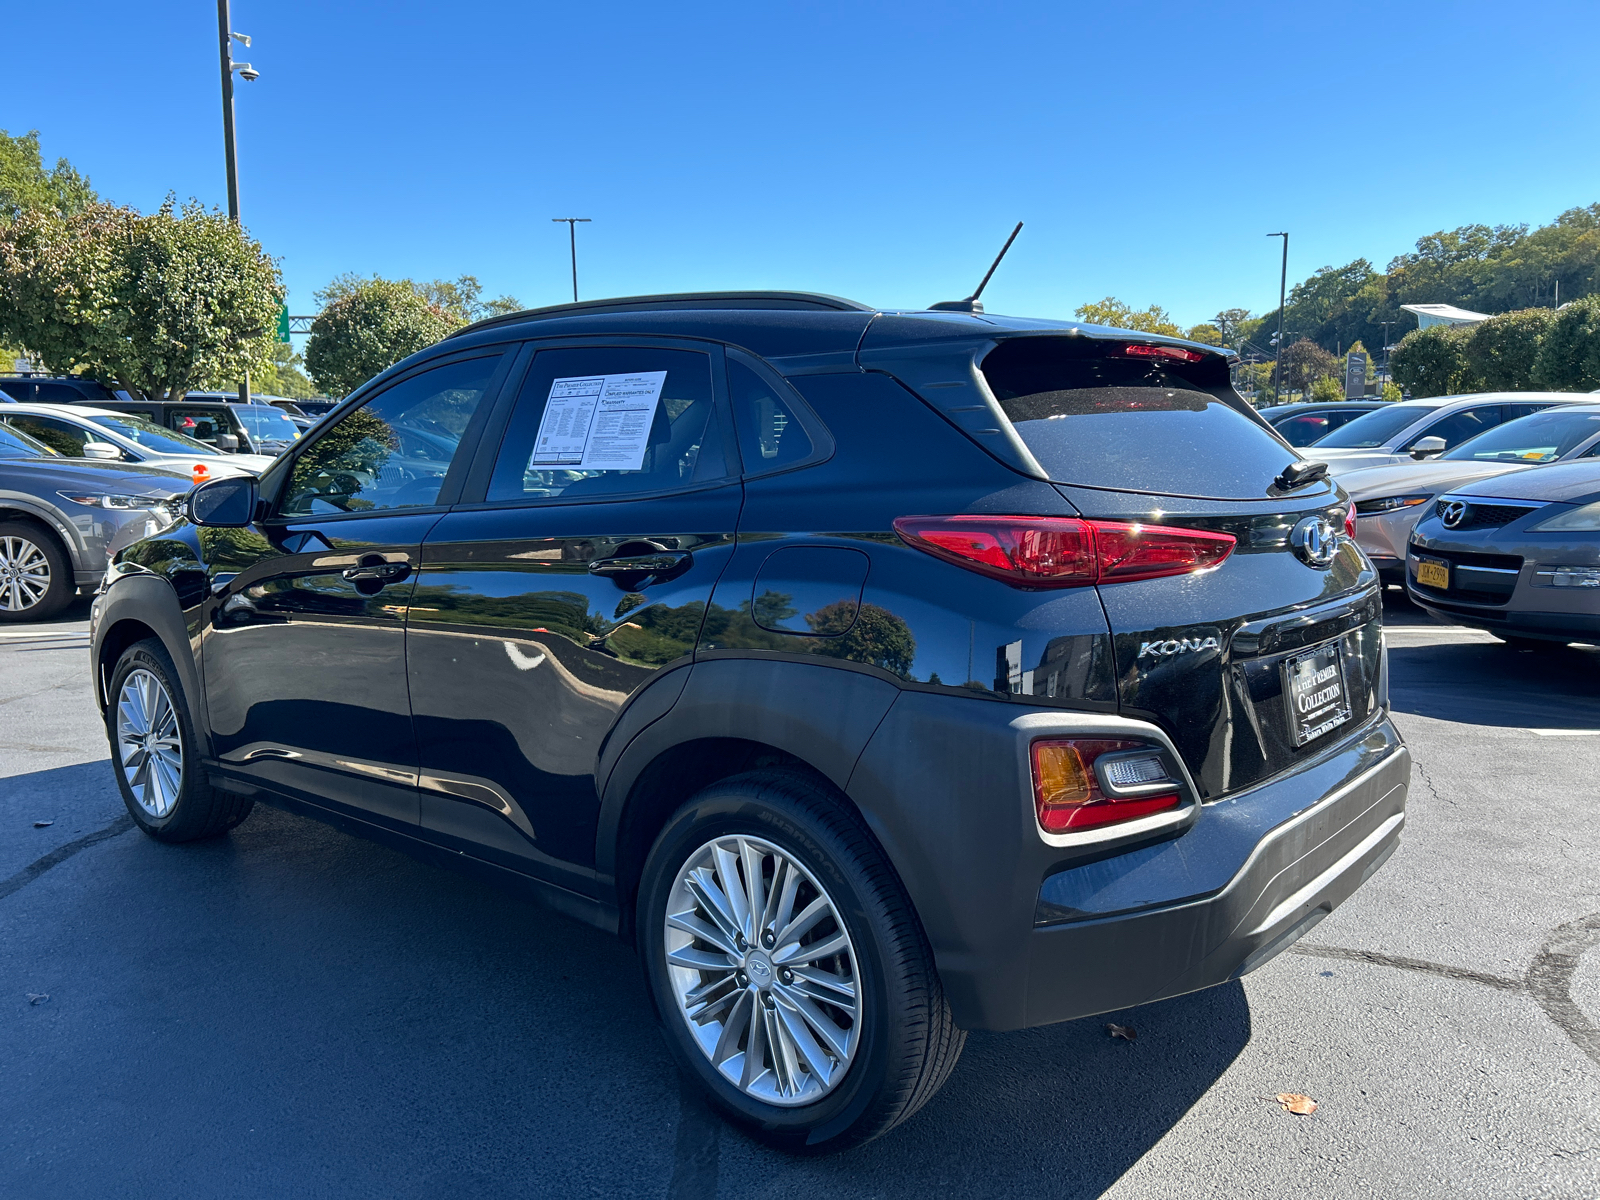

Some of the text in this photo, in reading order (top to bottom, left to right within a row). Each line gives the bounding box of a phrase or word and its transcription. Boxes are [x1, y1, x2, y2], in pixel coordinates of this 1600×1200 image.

[1137, 636, 1221, 659] KONA
[140, 652, 169, 682] KINERGY
[1294, 664, 1338, 692] THE PREMIER
[1298, 682, 1341, 713] COLLECTION
